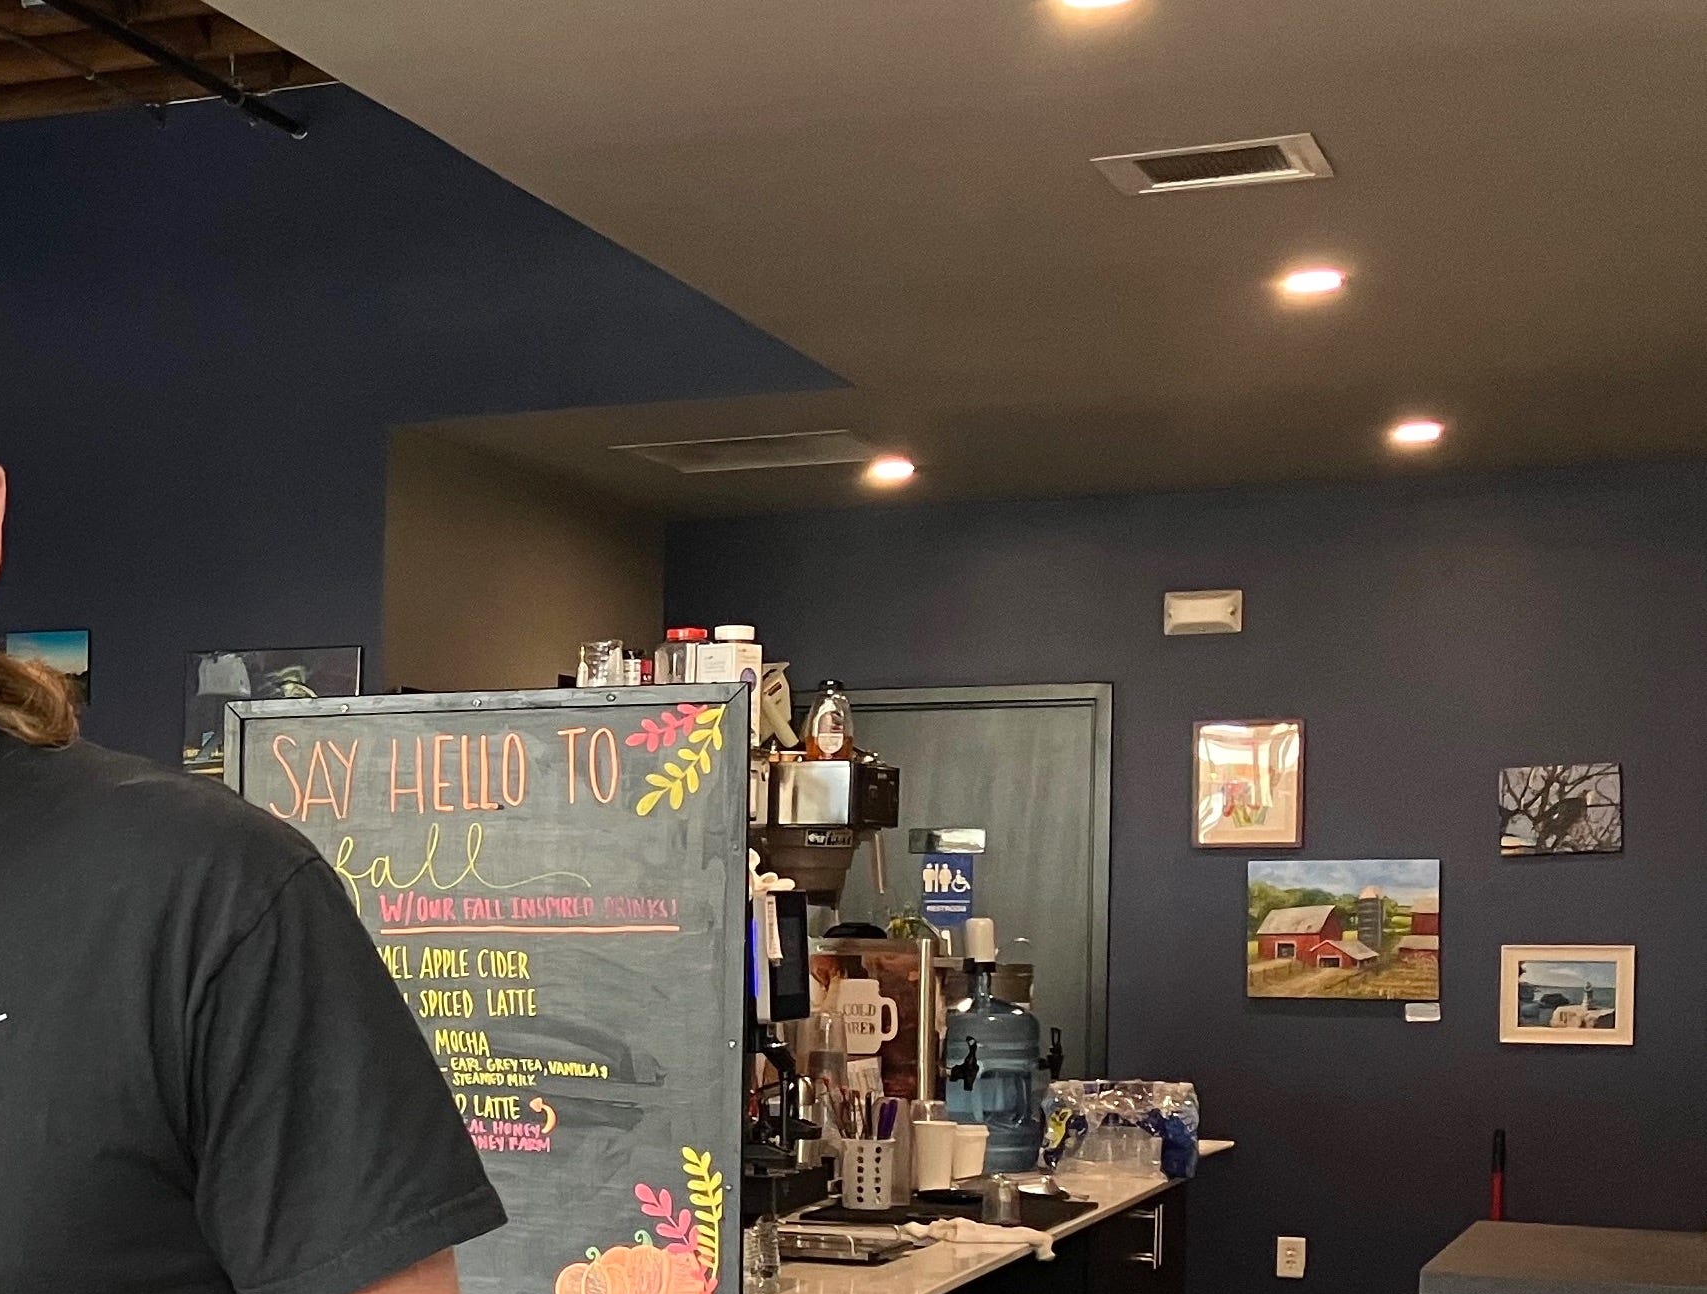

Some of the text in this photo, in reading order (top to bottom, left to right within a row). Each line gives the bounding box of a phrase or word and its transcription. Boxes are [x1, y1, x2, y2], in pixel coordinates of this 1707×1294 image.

[269, 727, 620, 823] SAY HELLO TO
[334, 822, 591, 918] fall
[463, 896, 505, 920] FALL
[419, 946, 470, 980] APPLE
[477, 948, 530, 980] CIDER
[419, 988, 474, 1018] SPICED
[487, 988, 537, 1017] LATTE
[843, 1004, 876, 1016] COLD
[435, 1028, 491, 1057] MOCHA
[451, 1056, 482, 1072] EARL
[487, 1057, 519, 1072] GREY
[452, 1072, 537, 1087] STEAMED MILK
[473, 1094, 520, 1120] LATTE
[492, 1120, 541, 1139] HONEY
